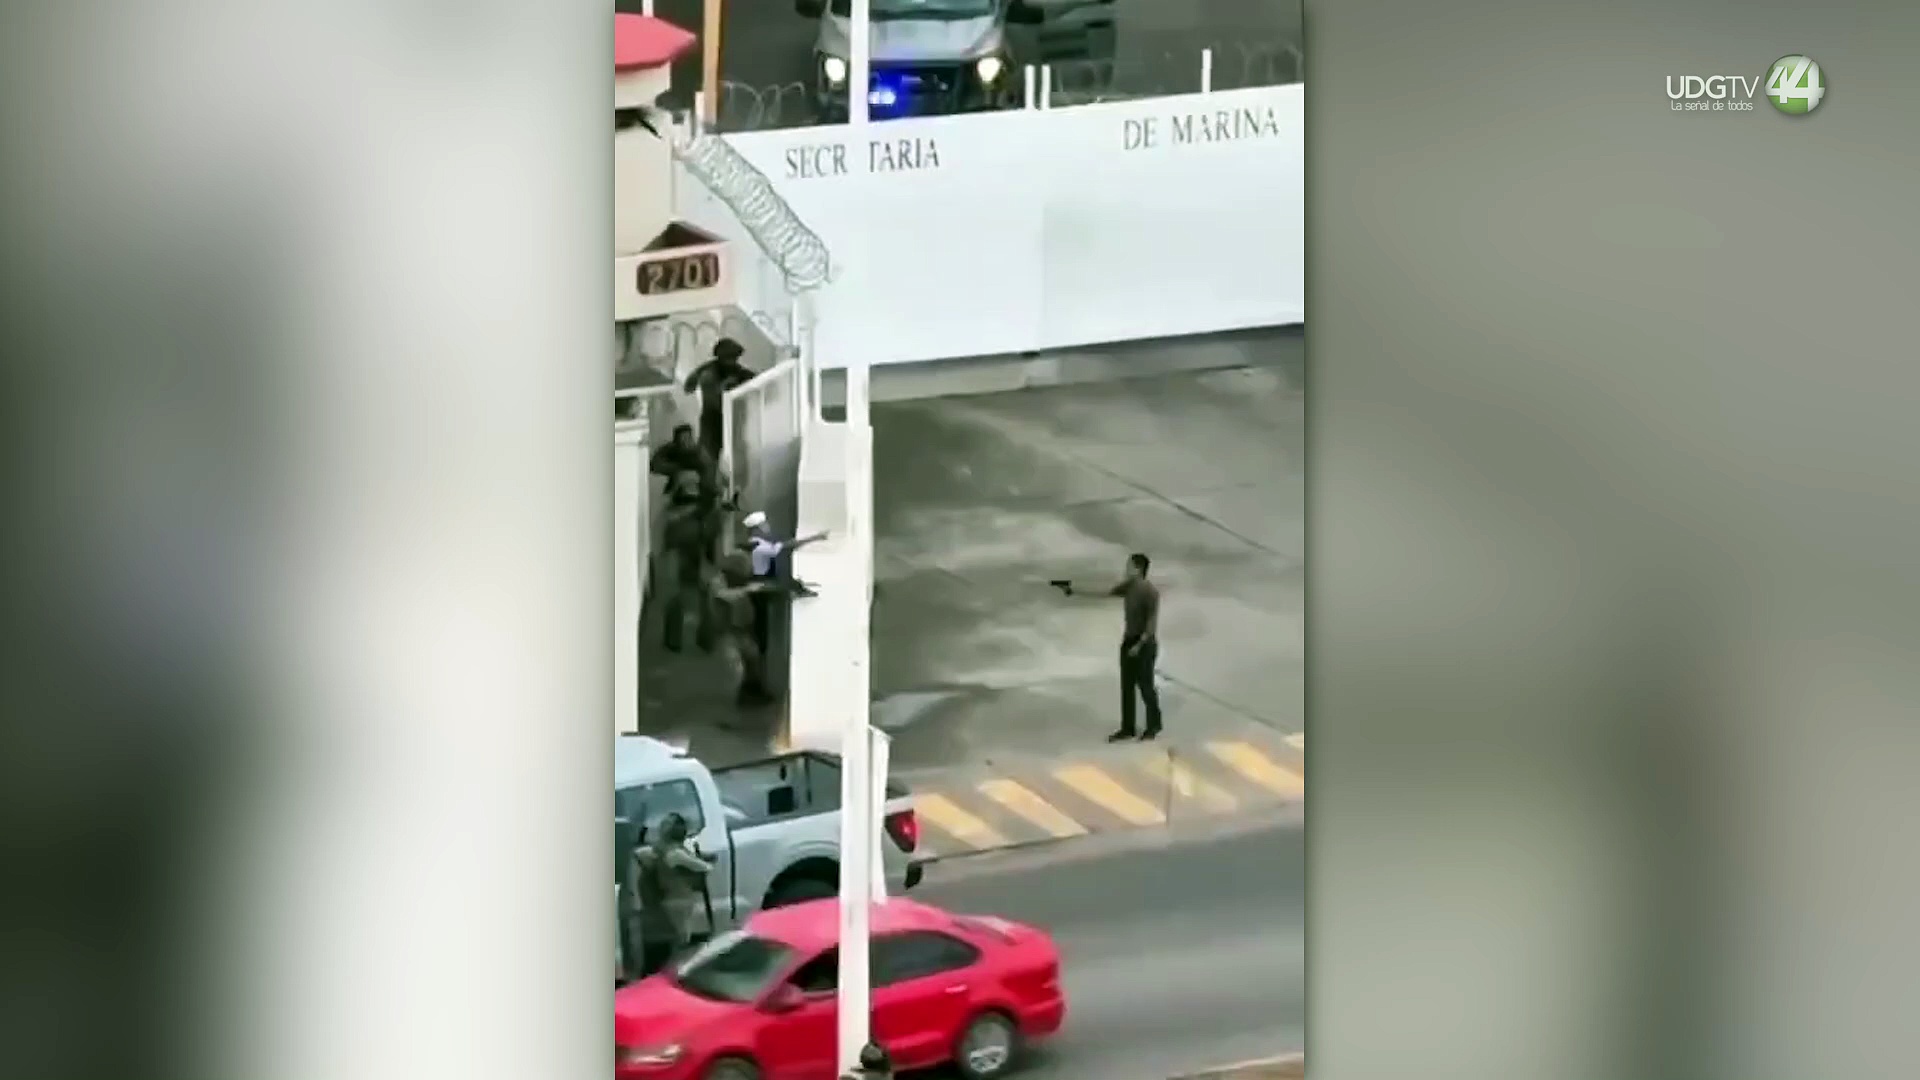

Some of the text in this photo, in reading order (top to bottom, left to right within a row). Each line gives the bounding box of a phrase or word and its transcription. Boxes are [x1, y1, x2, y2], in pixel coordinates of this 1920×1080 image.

[785, 106, 1279, 179] SECRTARIA DE MARINA
[646, 255, 717, 294] 2701
